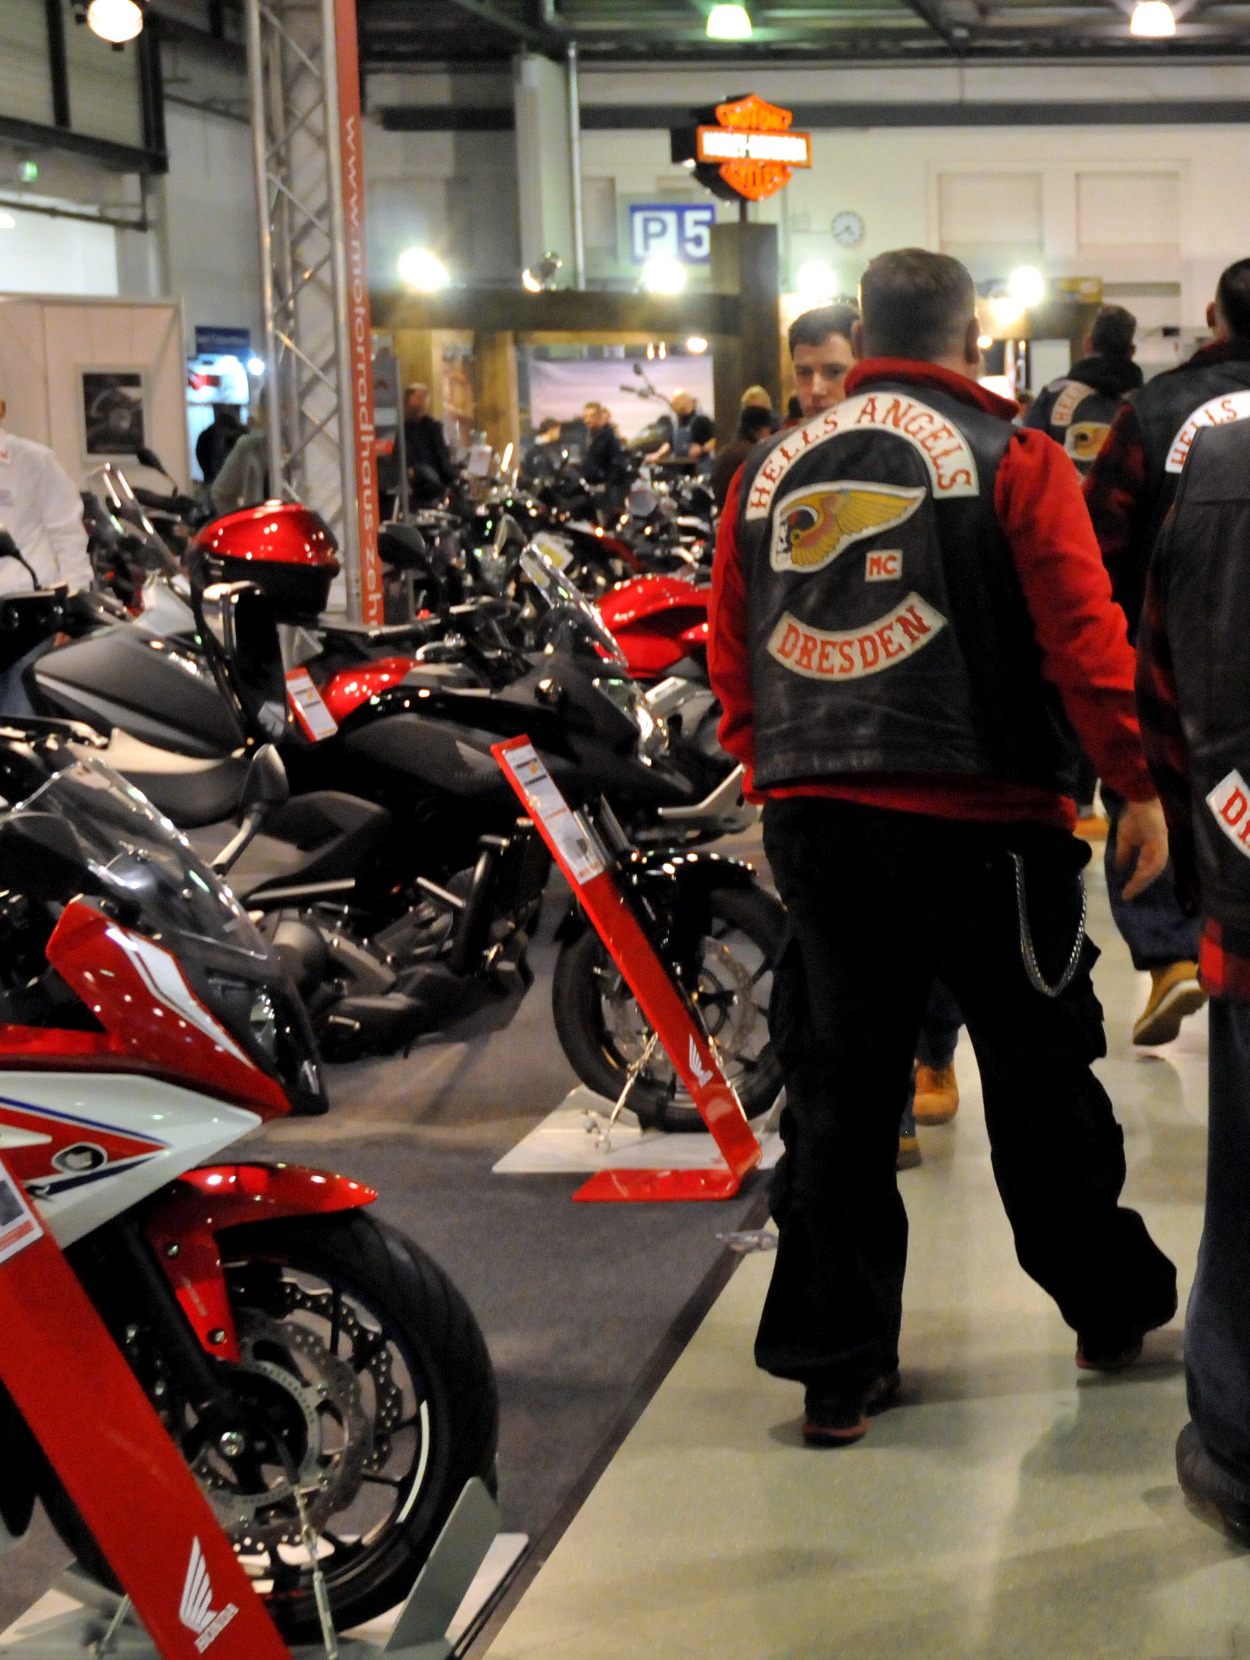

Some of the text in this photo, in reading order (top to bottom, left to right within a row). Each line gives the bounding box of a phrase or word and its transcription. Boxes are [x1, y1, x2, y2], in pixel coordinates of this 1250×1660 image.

[751, 396, 972, 509] HELLS ANGELS
[868, 555, 897, 576] MC
[777, 605, 931, 674] DRESDEN
